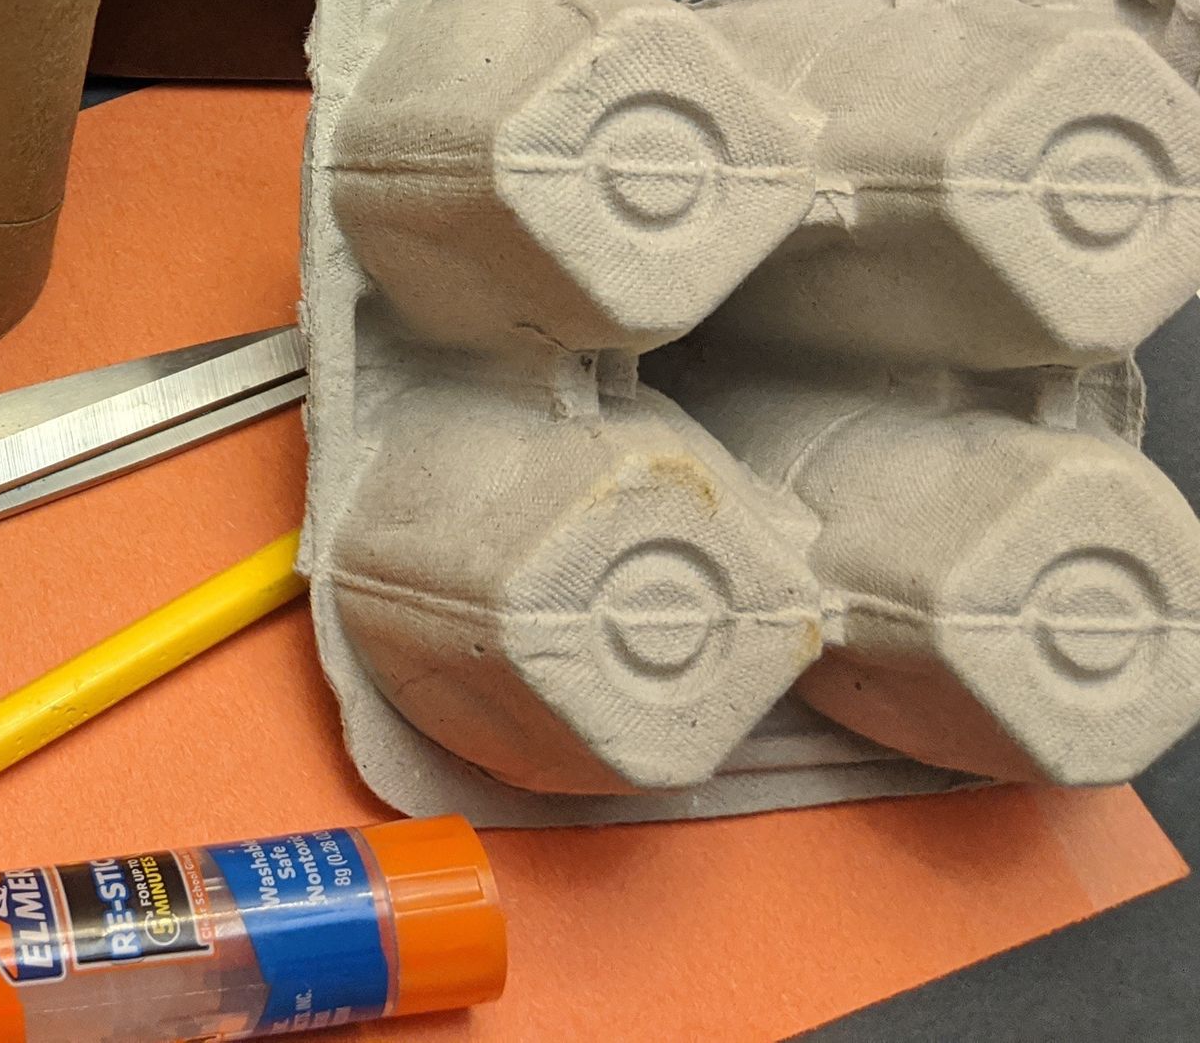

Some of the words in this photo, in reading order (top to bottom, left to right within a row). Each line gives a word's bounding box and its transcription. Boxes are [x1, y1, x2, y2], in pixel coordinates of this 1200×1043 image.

[127, 858, 140, 869] TO
[270, 845, 296, 880] Safe
[132, 868, 145, 884] UP
[334, 868, 352, 887] 8g
[136, 884, 152, 907] FOR
[140, 855, 172, 917] MINUTES
[152, 916, 175, 935] 5
